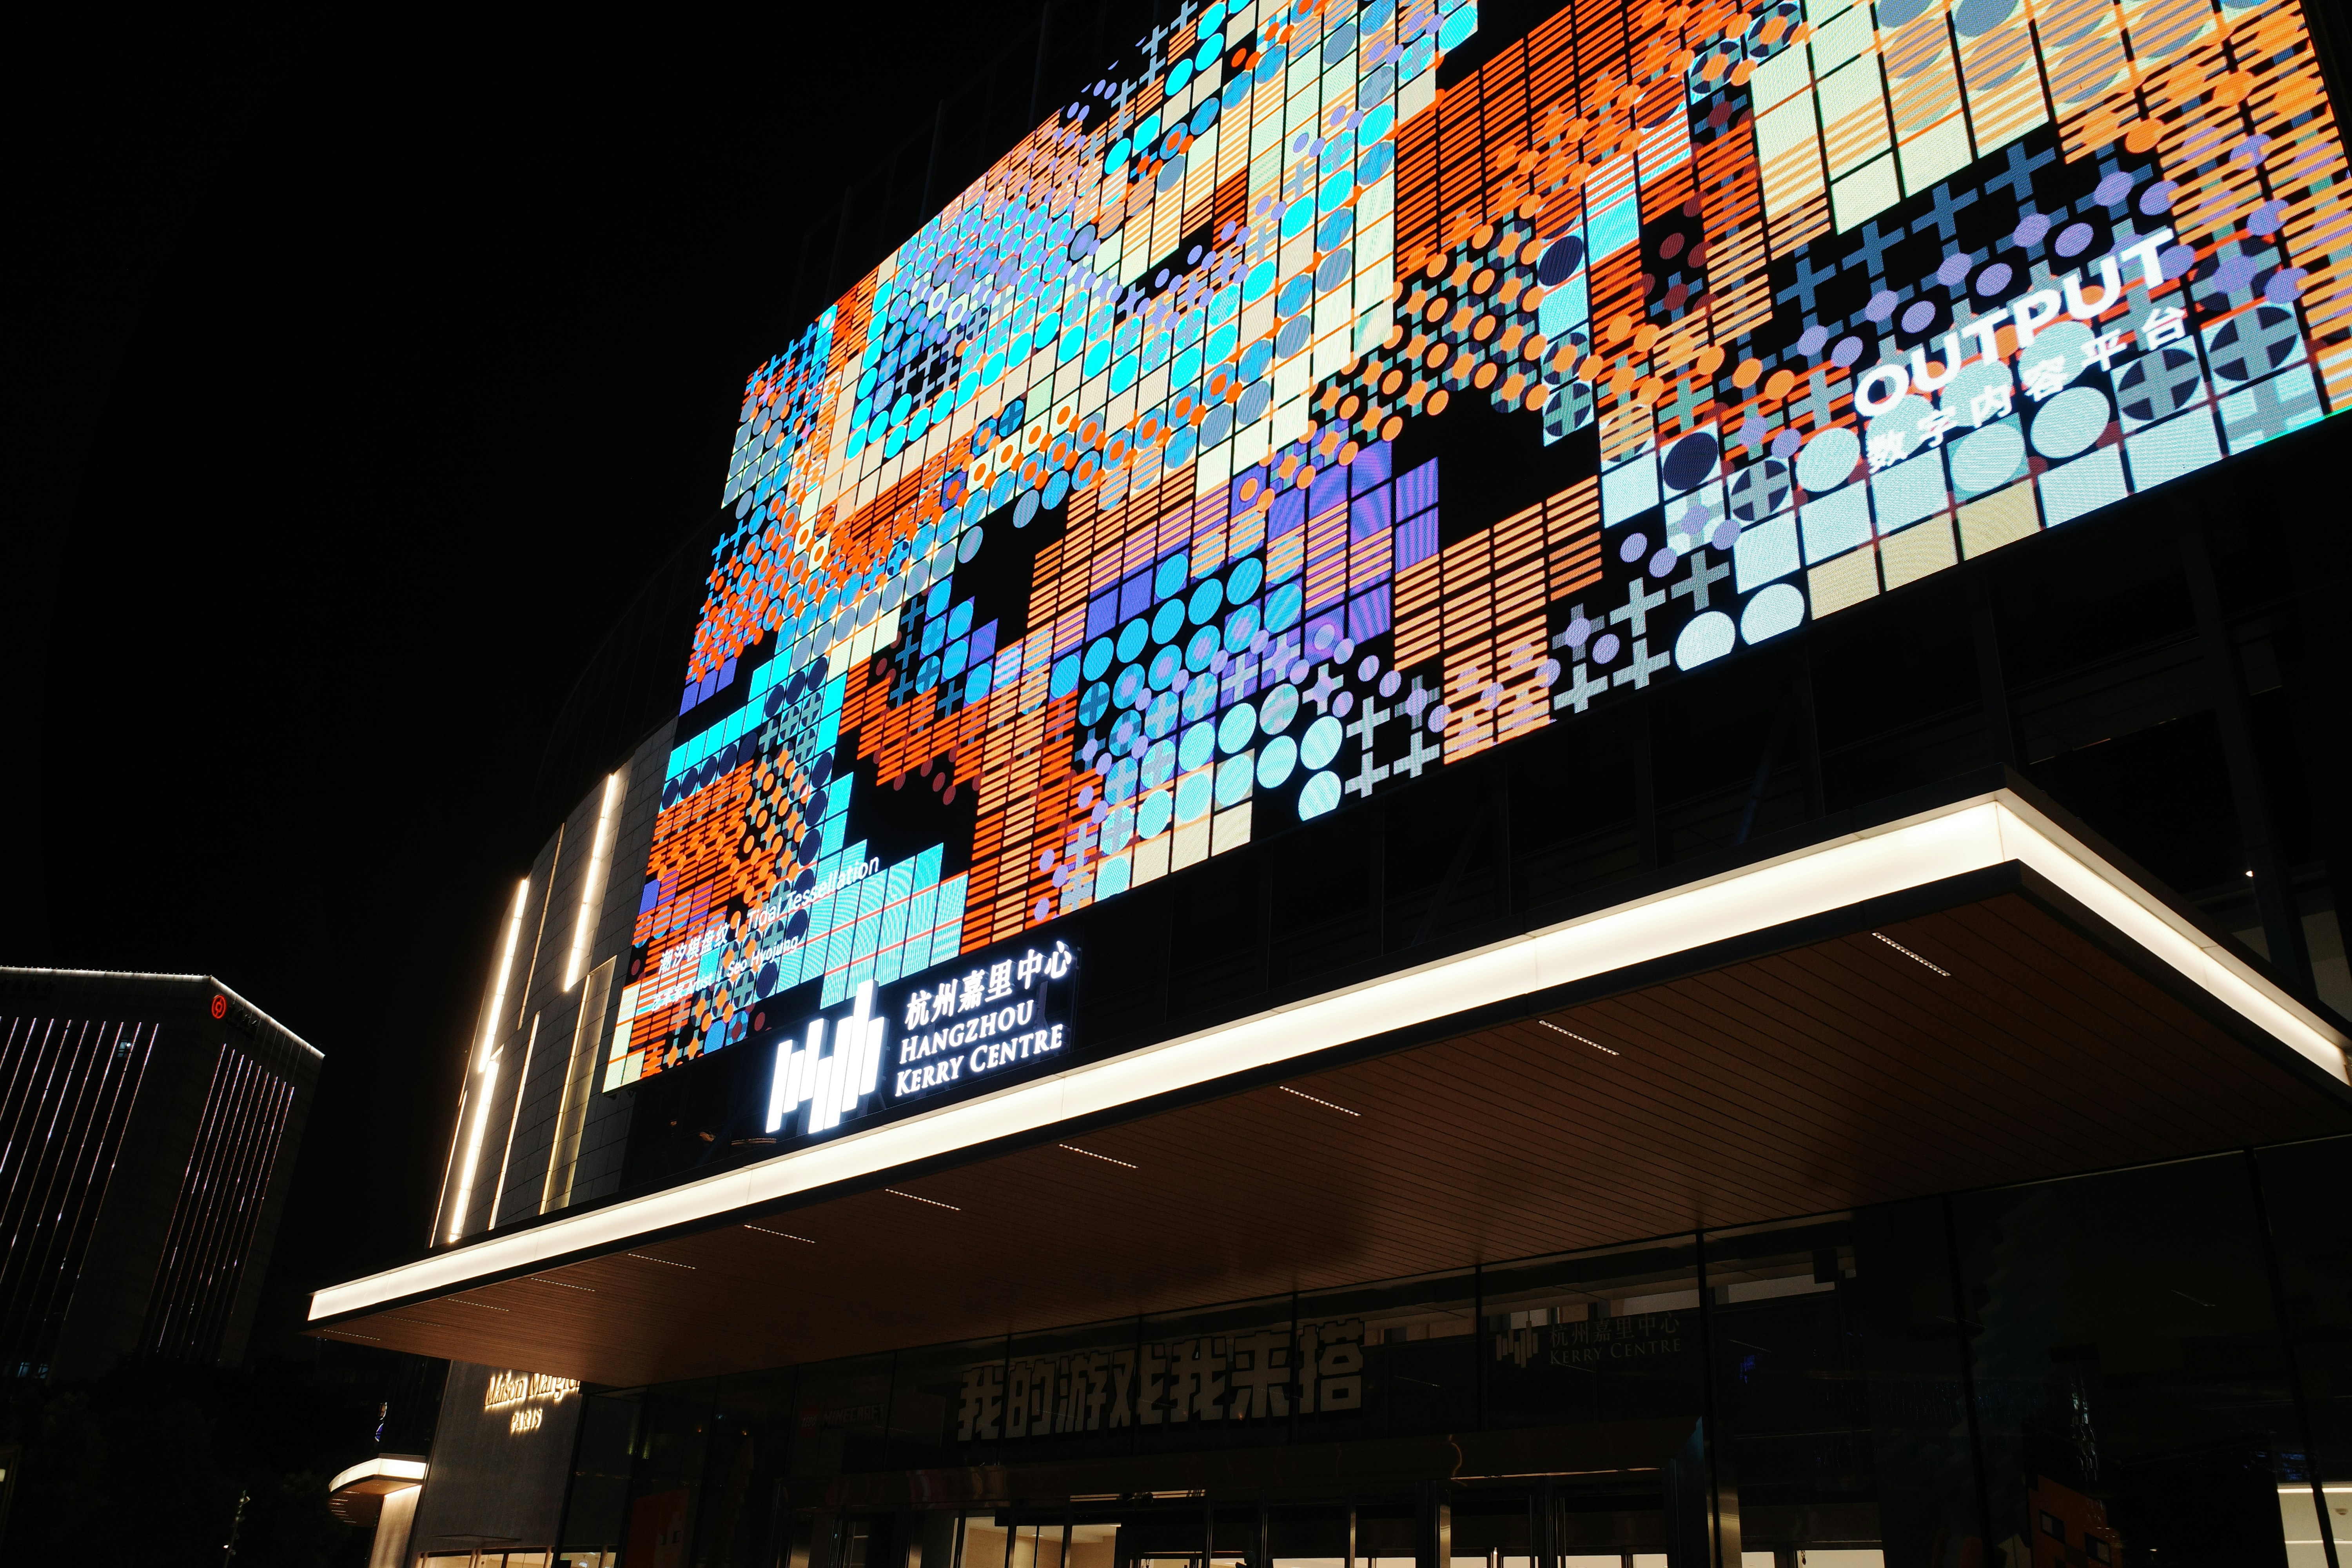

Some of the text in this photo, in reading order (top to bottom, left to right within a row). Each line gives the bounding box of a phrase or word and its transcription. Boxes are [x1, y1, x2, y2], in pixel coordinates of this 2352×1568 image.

[1855, 228, 2174, 417] OUTPUT
[1866, 307, 2187, 474] 数字内容平台
[658, 922, 730, 975] 潮汐棋盘纹
[746, 902, 782, 933] Tidal
[786, 856, 880, 911] Tessellation
[727, 959, 748, 977] Seo
[751, 936, 799, 969] Hyojung
[905, 941, 1072, 1030] 杭州嘉里中心
[895, 1024, 1063, 1096] KERRY CENTRE
[899, 1000, 1034, 1064] HANGZHOU
[1549, 1312, 1680, 1348] 杭州嘉里中心
[1550, 1338, 1681, 1365] KERRY CENTRE
[484, 1373, 524, 1406] Maison
[957, 1318, 1365, 1441] 我的游戏我来搭
[510, 1410, 543, 1430] PARIS
[802, 1403, 885, 1427] LEGO MINECRAFT
